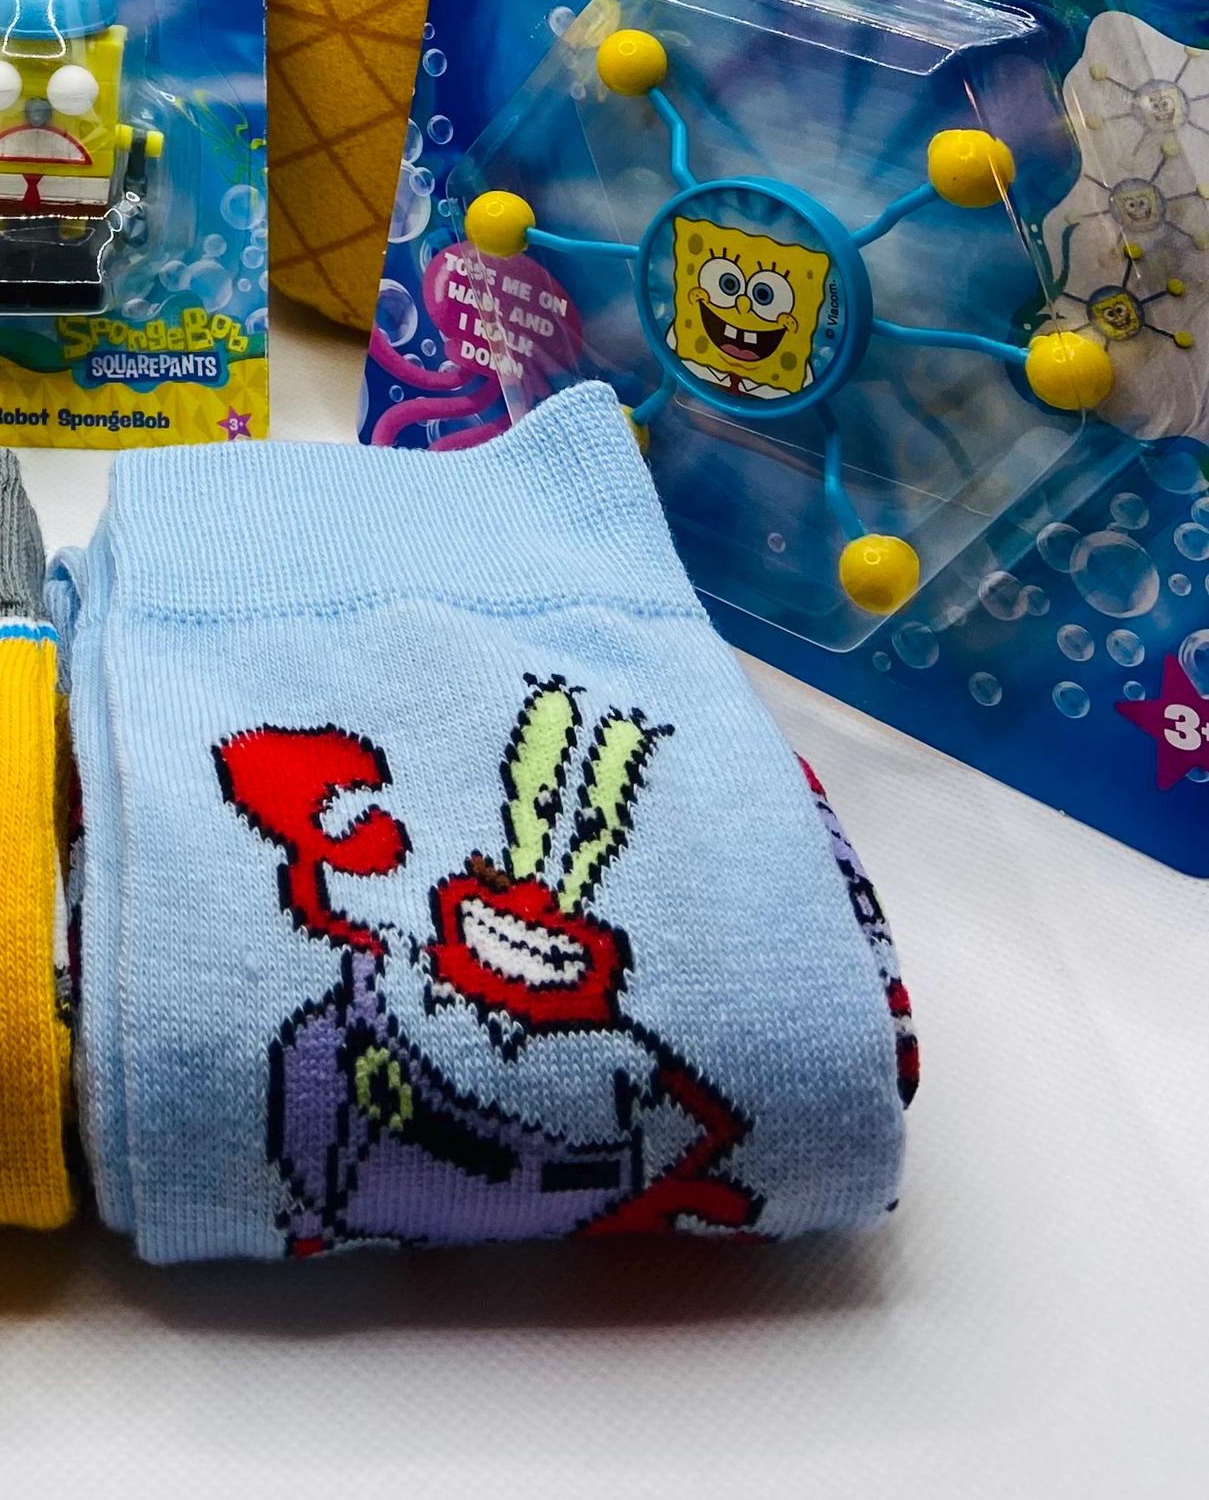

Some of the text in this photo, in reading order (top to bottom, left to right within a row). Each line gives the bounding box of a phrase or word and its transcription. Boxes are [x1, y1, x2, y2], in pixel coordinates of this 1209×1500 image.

[502, 276, 532, 302] ME
[539, 291, 568, 317] ON
[56, 308, 248, 357] SpongeBob
[509, 306, 554, 337] AND
[91, 353, 218, 380] SQUAREPANTS
[57, 408, 171, 431] SpongeBob
[229, 417, 245, 432] 3+
